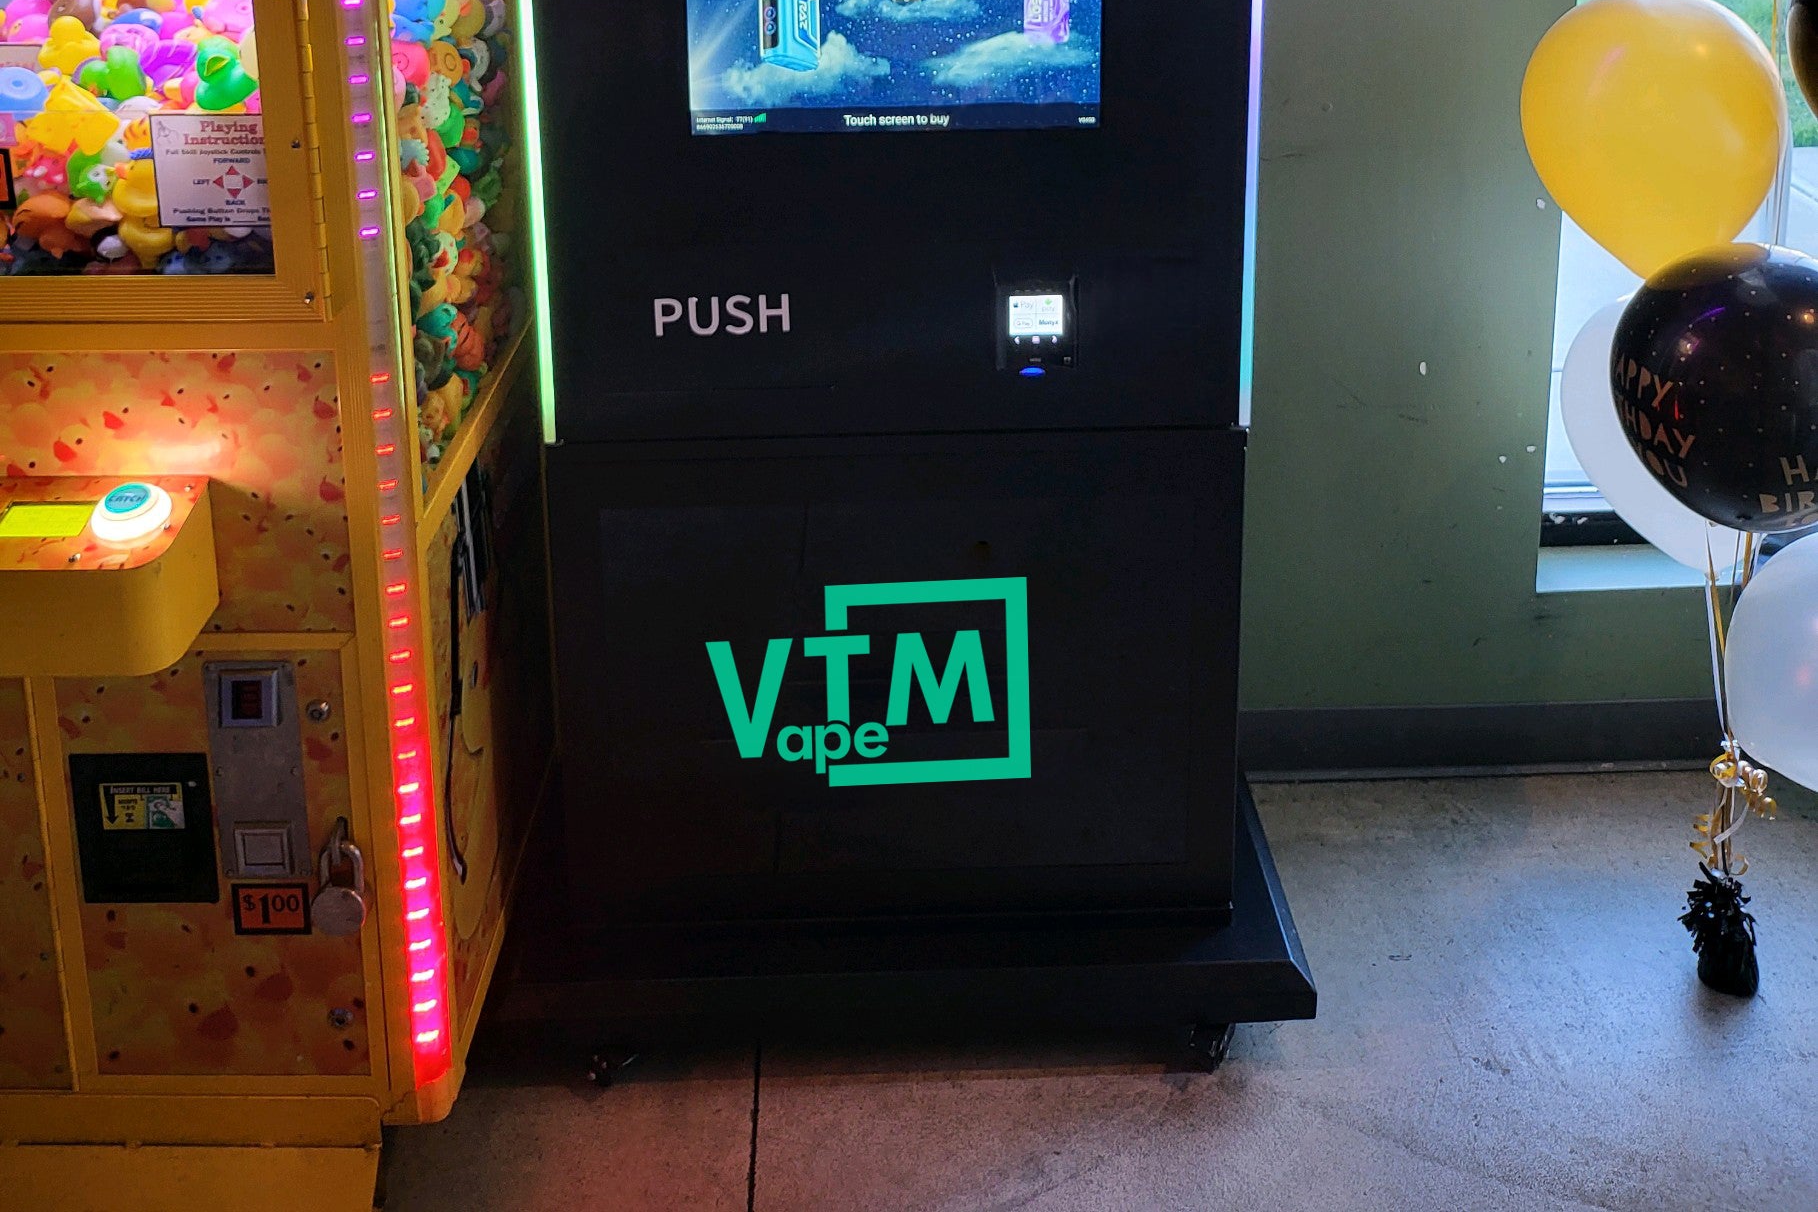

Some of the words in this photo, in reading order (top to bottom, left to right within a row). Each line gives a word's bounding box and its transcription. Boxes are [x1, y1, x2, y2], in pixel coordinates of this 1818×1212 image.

[798, 0, 809, 30] RAZ
[200, 120, 258, 134] Playing
[844, 114, 876, 126] Touch
[879, 115, 914, 126] screen
[916, 114, 928, 125] to
[929, 113, 950, 127] buy
[653, 293, 791, 337] PUSH
